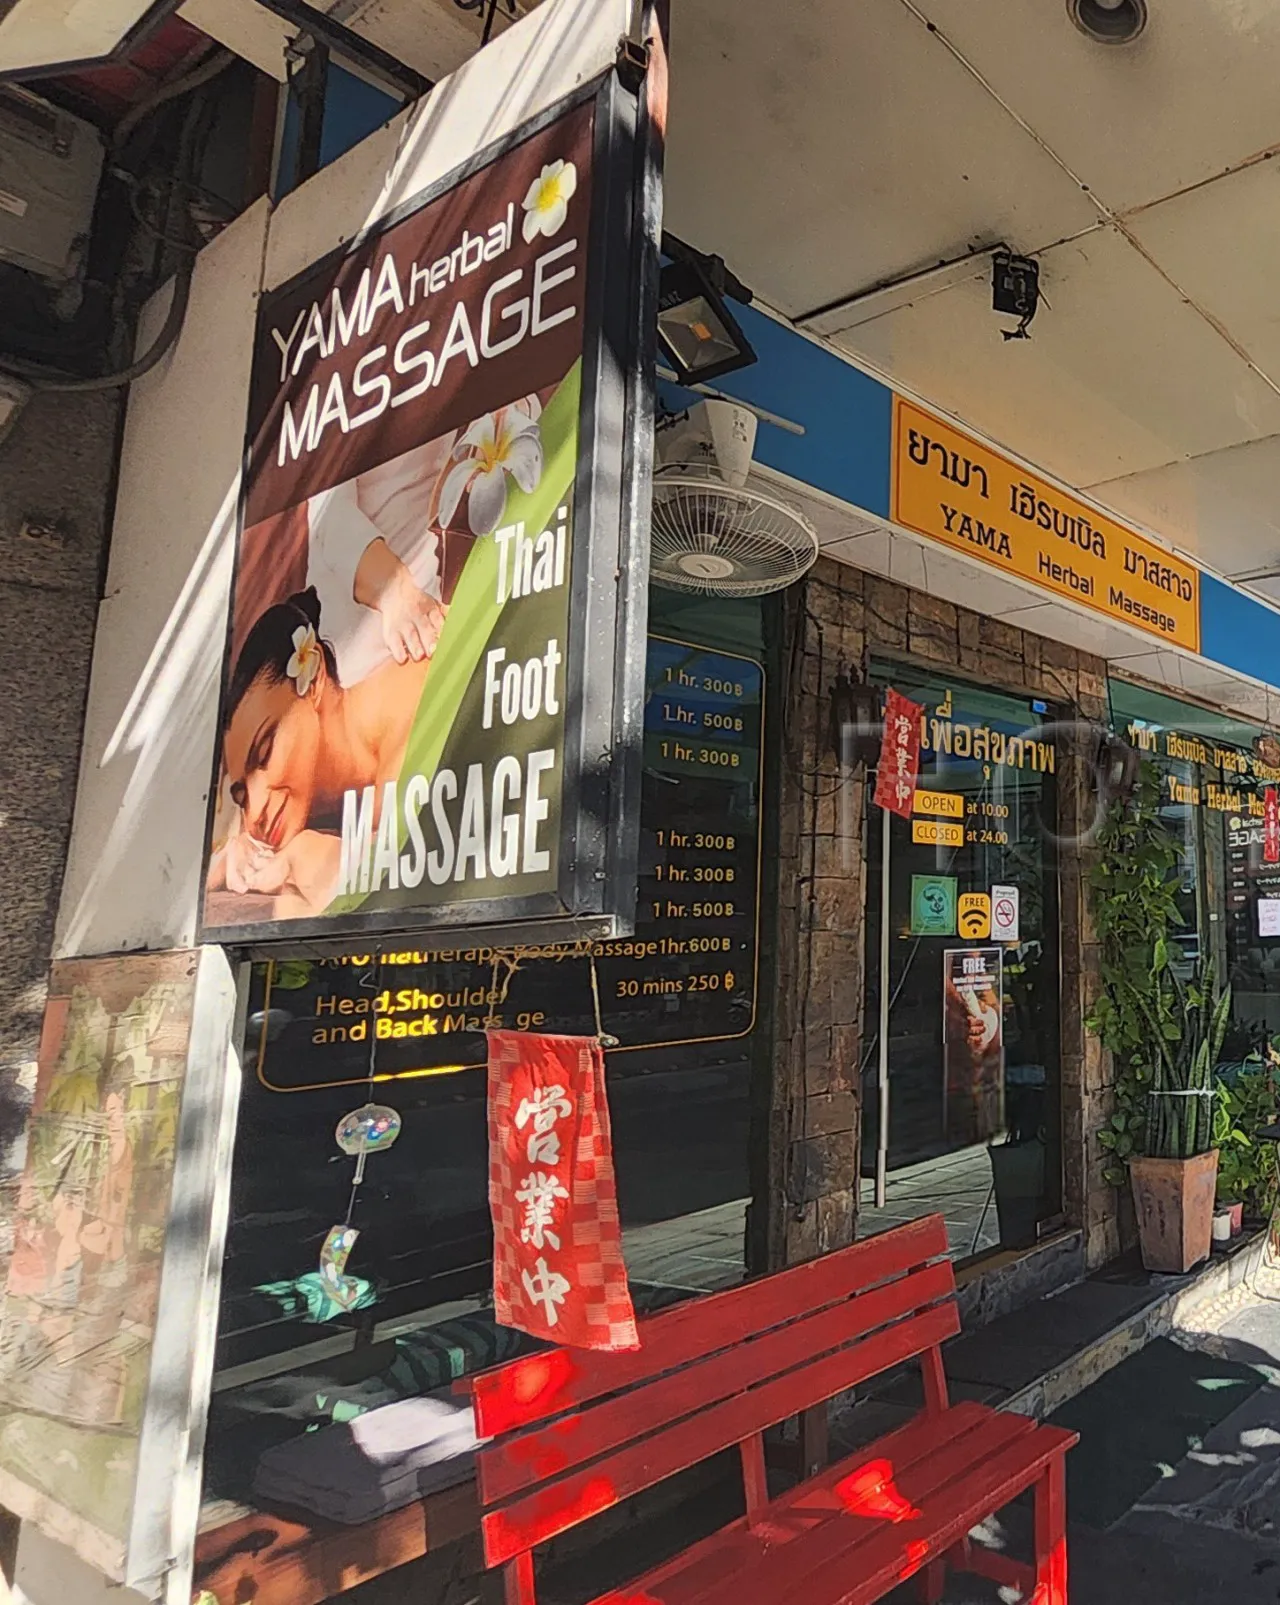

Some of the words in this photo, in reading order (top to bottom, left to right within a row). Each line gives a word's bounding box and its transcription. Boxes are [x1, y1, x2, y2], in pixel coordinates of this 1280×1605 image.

[271, 254, 404, 382] YAMA
[409, 202, 514, 306] herbal
[277, 238, 577, 467] MASSAGE
[908, 429, 990, 499] ยามา
[495, 506, 567, 604] Thai
[939, 503, 1013, 560] YAMA
[1038, 551, 1094, 597] Herbal
[1109, 586, 1176, 633] Massage
[482, 639, 561, 730] Foot
[665, 667, 672, 682] 1
[679, 669, 699, 688] hr.
[677, 705, 697, 725] hr.
[920, 689, 1055, 780] เพื่อสุขภาพ
[661, 742, 668, 758] 1
[675, 742, 695, 761] hr.
[922, 796, 956, 812] OPEN
[967, 803, 978, 815] at
[981, 803, 1009, 818] 10.00
[1168, 775, 1200, 805] Yama
[1207, 784, 1241, 813] Herbal
[338, 748, 556, 896] MASSAGE
[916, 825, 959, 841] CLOSED
[967, 830, 978, 843] at
[980, 829, 1008, 845] 24.00
[656, 831, 664, 846] 1
[670, 830, 691, 847] hr.
[655, 865, 662, 881] 1
[669, 864, 690, 881] hr.
[653, 902, 660, 917] 1
[667, 901, 688, 917] hr.
[965, 896, 985, 908] FREE
[963, 957, 986, 974] FREE
[616, 980, 638, 997] 30
[643, 977, 683, 996] mins
[687, 974, 719, 991] 250
[316, 986, 505, 1016] Head,Shoulde
[312, 1020, 367, 1045] and
[376, 1014, 438, 1040] Back
[443, 1011, 545, 1034] Massge
[514, 1084, 573, 1327] 営業中
